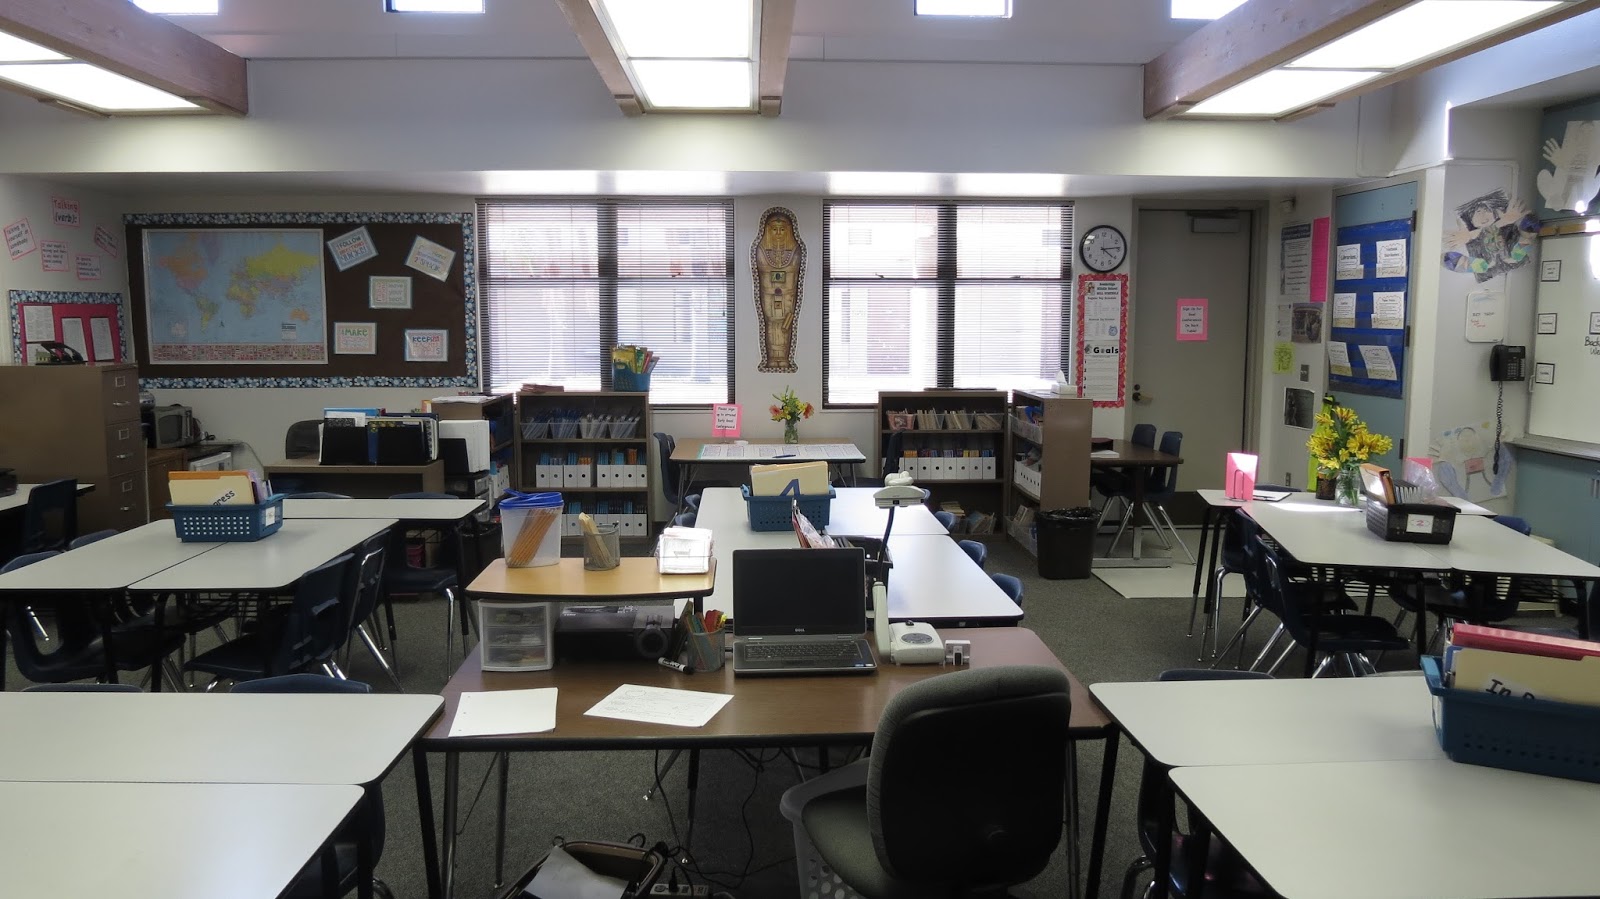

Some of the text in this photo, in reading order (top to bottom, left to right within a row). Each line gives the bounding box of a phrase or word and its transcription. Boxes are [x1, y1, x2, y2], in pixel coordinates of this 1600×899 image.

[54, 199, 78, 212] Talking
[55, 212, 78, 224] (verb):
[339, 236, 361, 248] FOLLOW
[344, 328, 368, 336] MAKE
[1093, 346, 1119, 354] Goals
[1416, 519, 1424, 527] 2
